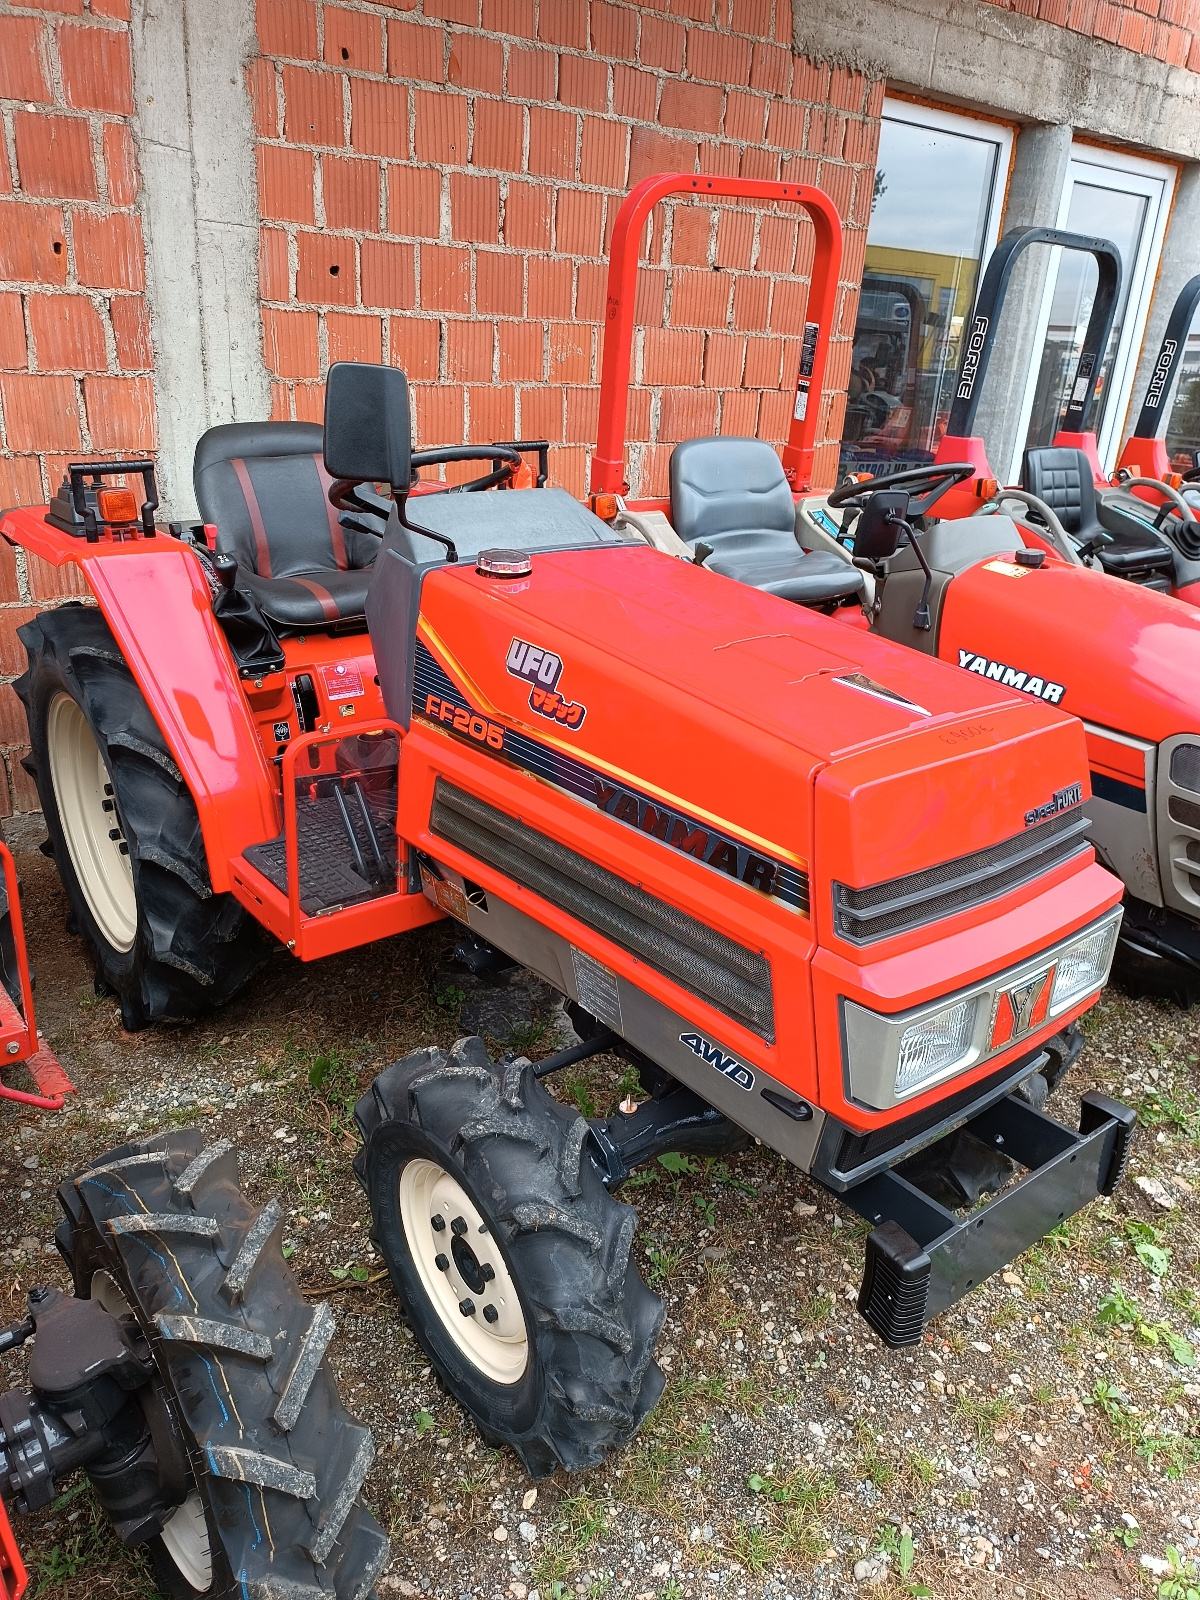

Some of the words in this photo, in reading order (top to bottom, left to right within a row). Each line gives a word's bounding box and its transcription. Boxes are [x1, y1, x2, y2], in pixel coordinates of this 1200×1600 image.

[957, 316, 988, 399] FORTE
[1146, 339, 1177, 408] FORTE
[506, 638, 561, 686] UFO
[958, 649, 1064, 704] YANMAR
[425, 693, 505, 749] FF205
[532, 687, 583, 725] マチック
[593, 777, 778, 896] YANMAR
[679, 1032, 755, 1091] 4WD
